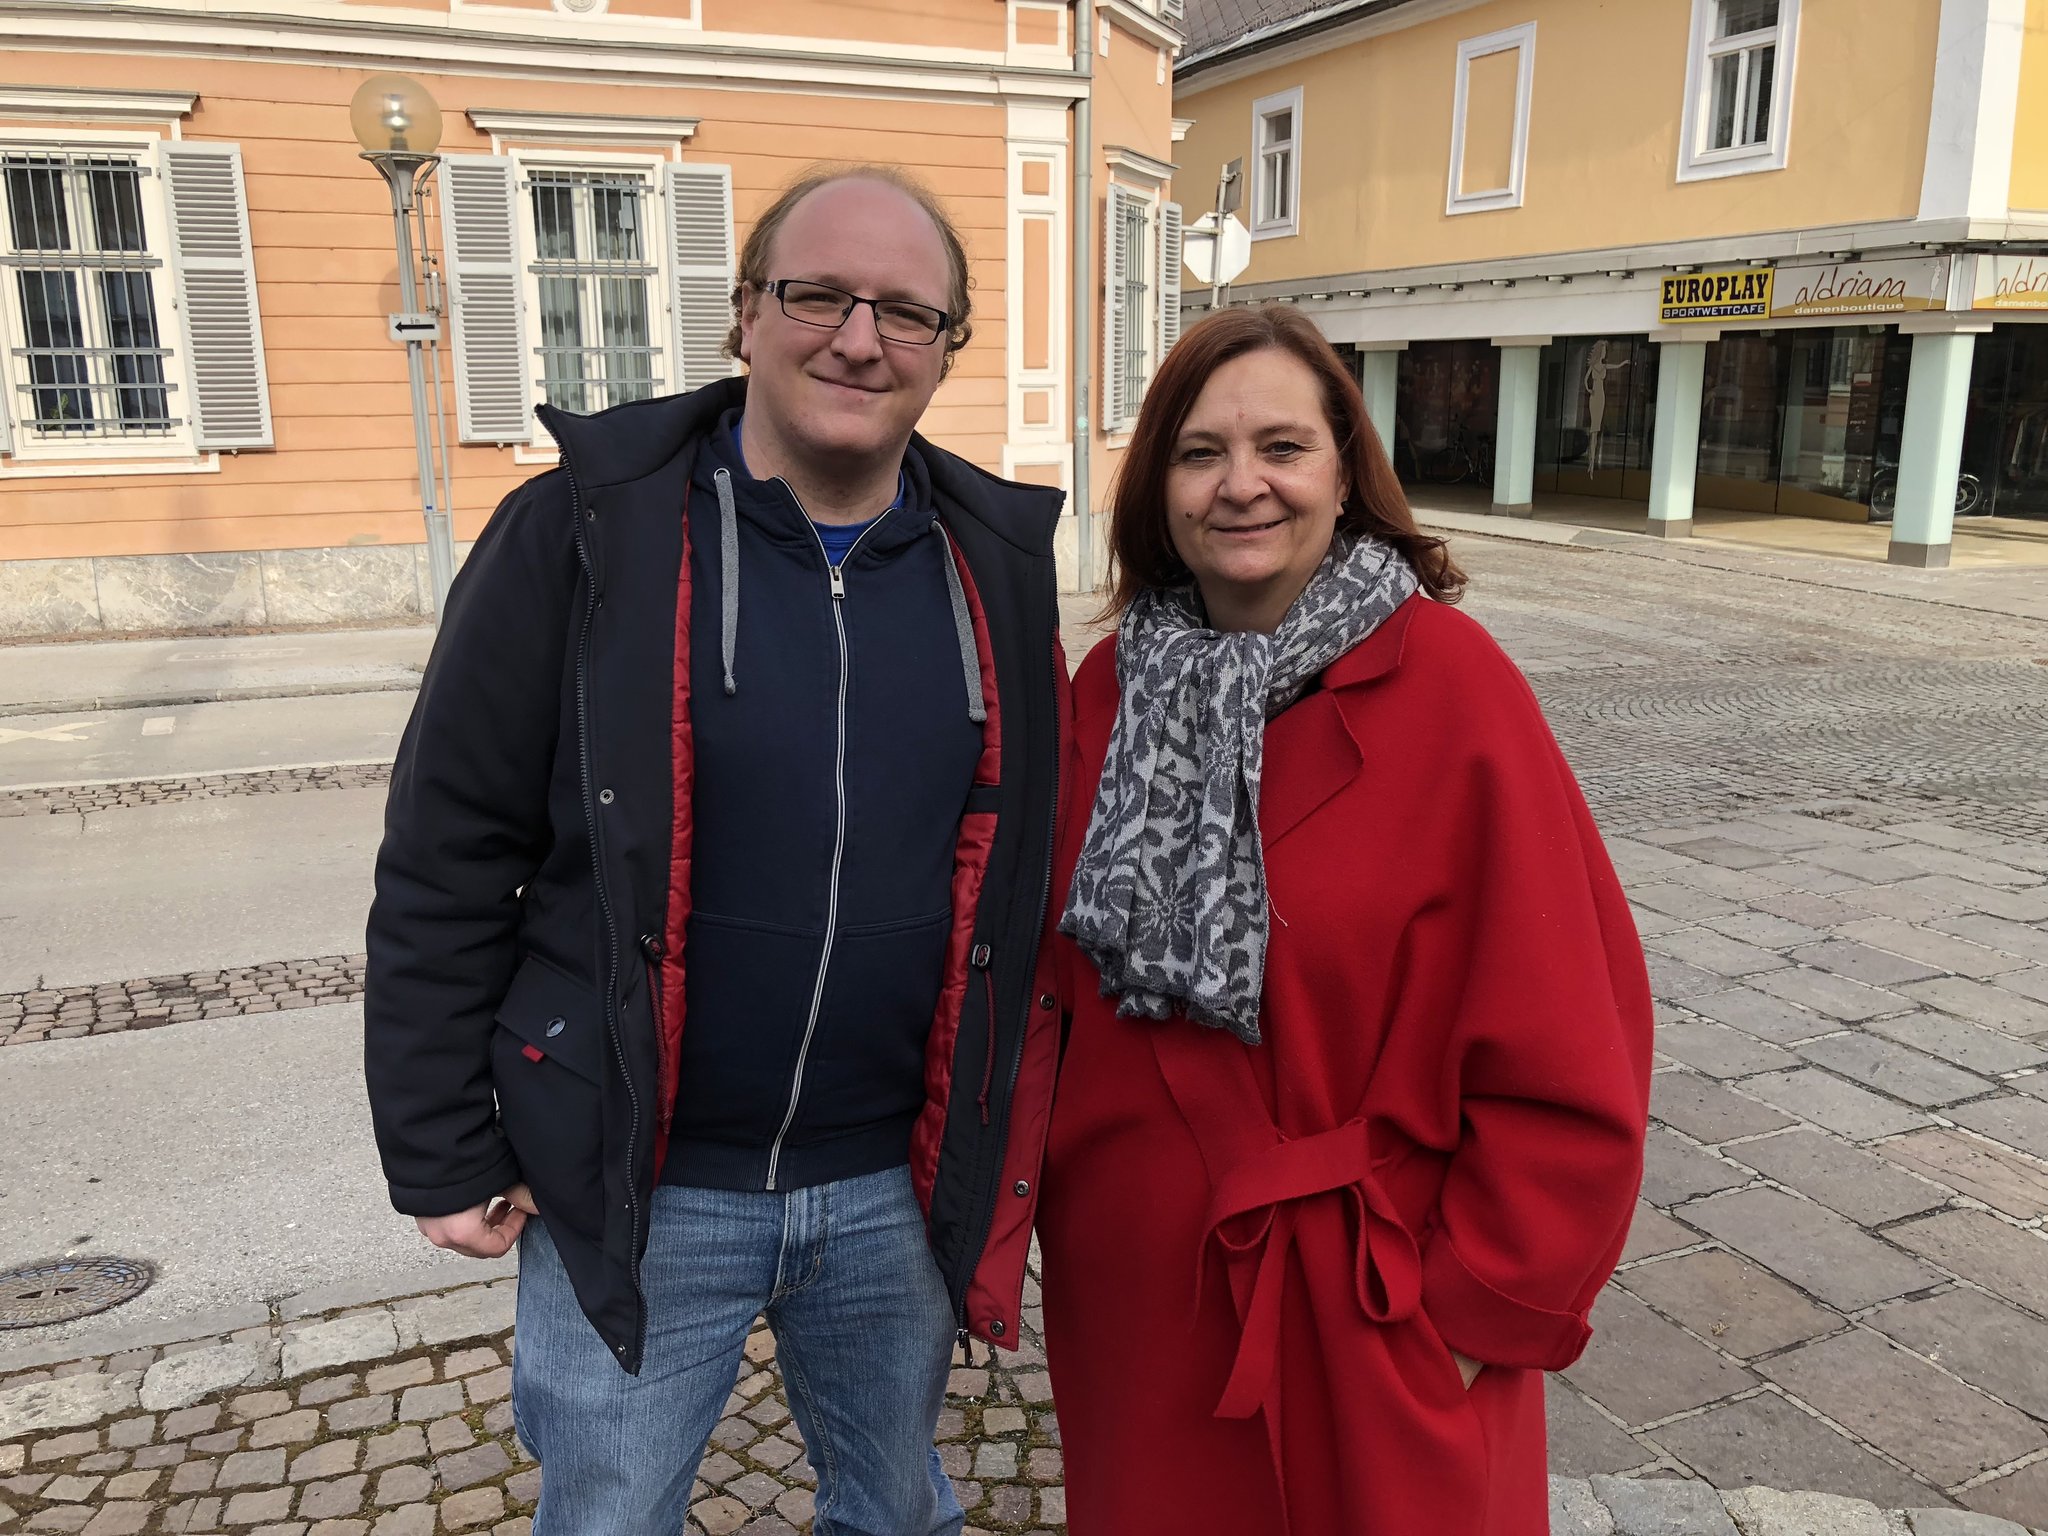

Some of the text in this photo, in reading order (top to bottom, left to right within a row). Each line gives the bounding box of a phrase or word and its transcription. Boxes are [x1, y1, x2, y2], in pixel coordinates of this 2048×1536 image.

[1663, 273, 1768, 304] EUROPLAY
[1663, 304, 1765, 318] SPORTWETTCAFE
[1794, 302, 1905, 315] damenboutique
